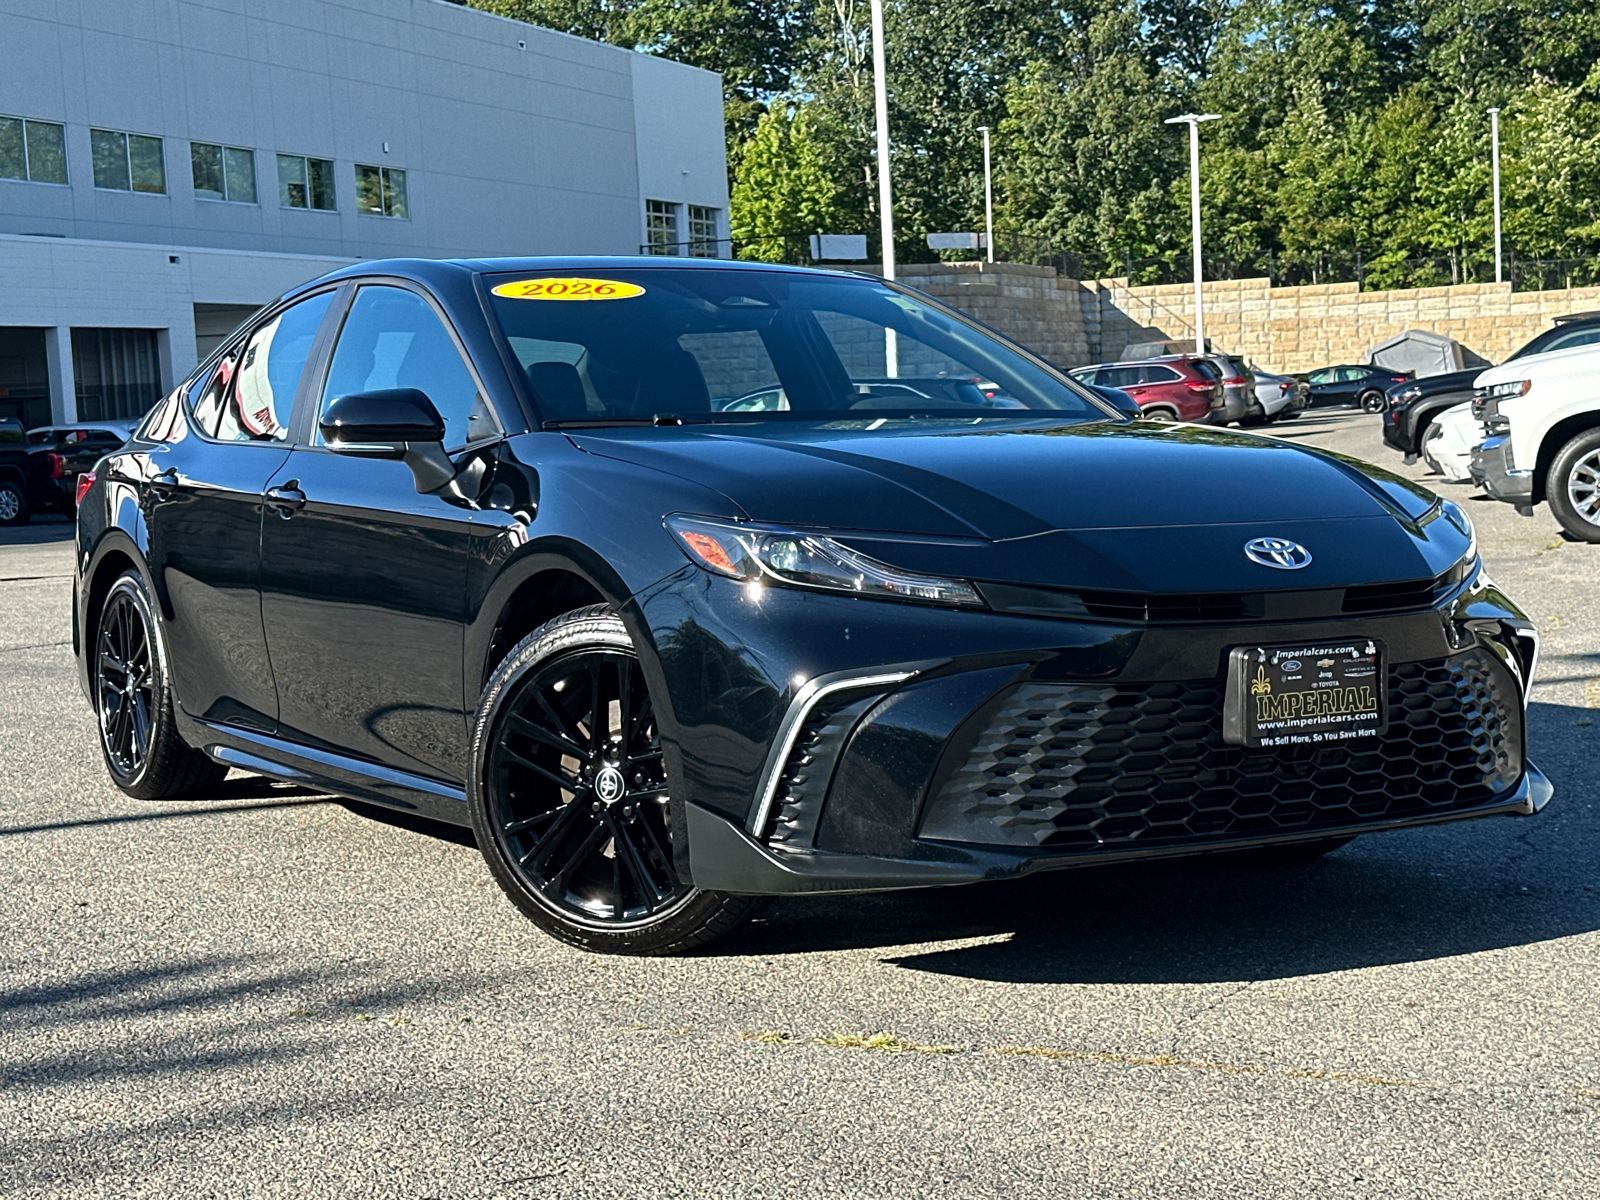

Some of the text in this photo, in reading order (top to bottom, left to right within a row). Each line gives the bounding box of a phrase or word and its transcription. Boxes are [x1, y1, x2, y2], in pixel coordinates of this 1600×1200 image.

[521, 283, 617, 296] 2026
[1276, 646, 1355, 659] Imperialcars.com
[1256, 686, 1377, 721] IMPERIAL
[1257, 712, 1378, 730] www.imperialcars.com
[1260, 728, 1377, 746] We Sell More, So You Save More
